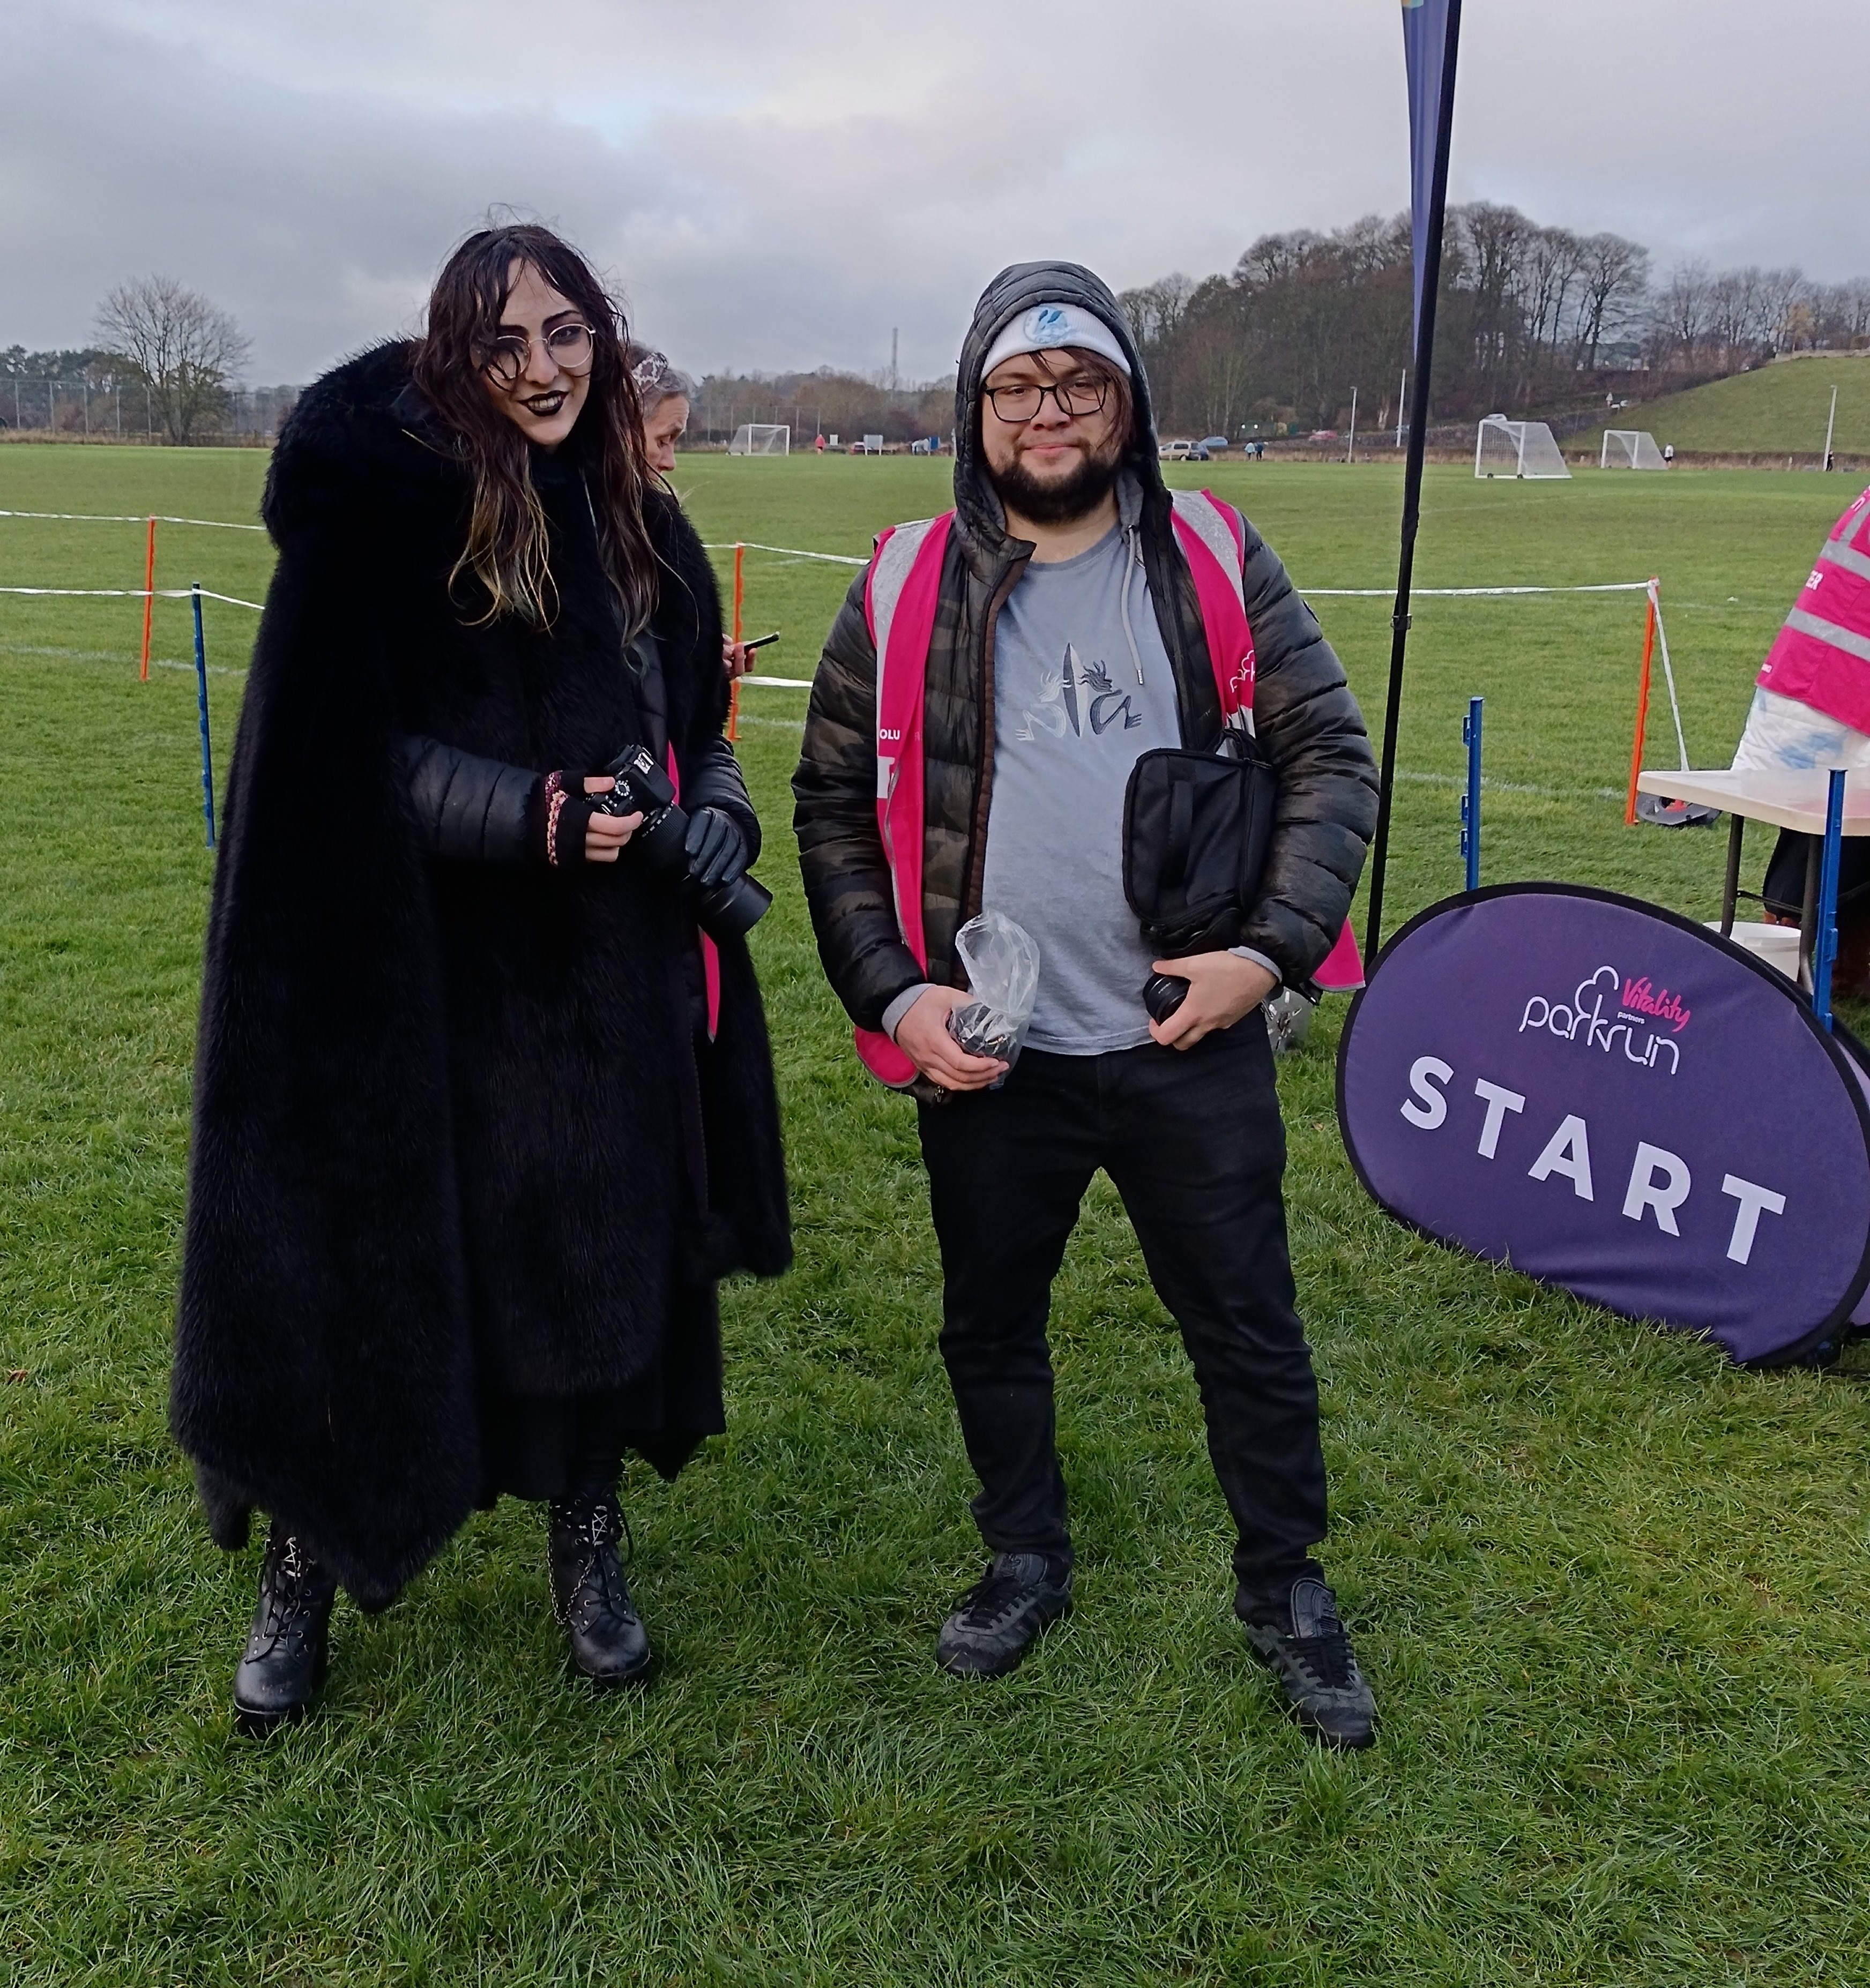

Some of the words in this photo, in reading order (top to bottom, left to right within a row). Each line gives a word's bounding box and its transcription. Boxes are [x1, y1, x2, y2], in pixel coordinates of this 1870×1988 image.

[1518, 965, 1680, 1075] parkrun
[1616, 1011, 1646, 1025] partners
[1622, 976, 1691, 1033] Vitality
[1400, 1056, 1786, 1265] START
